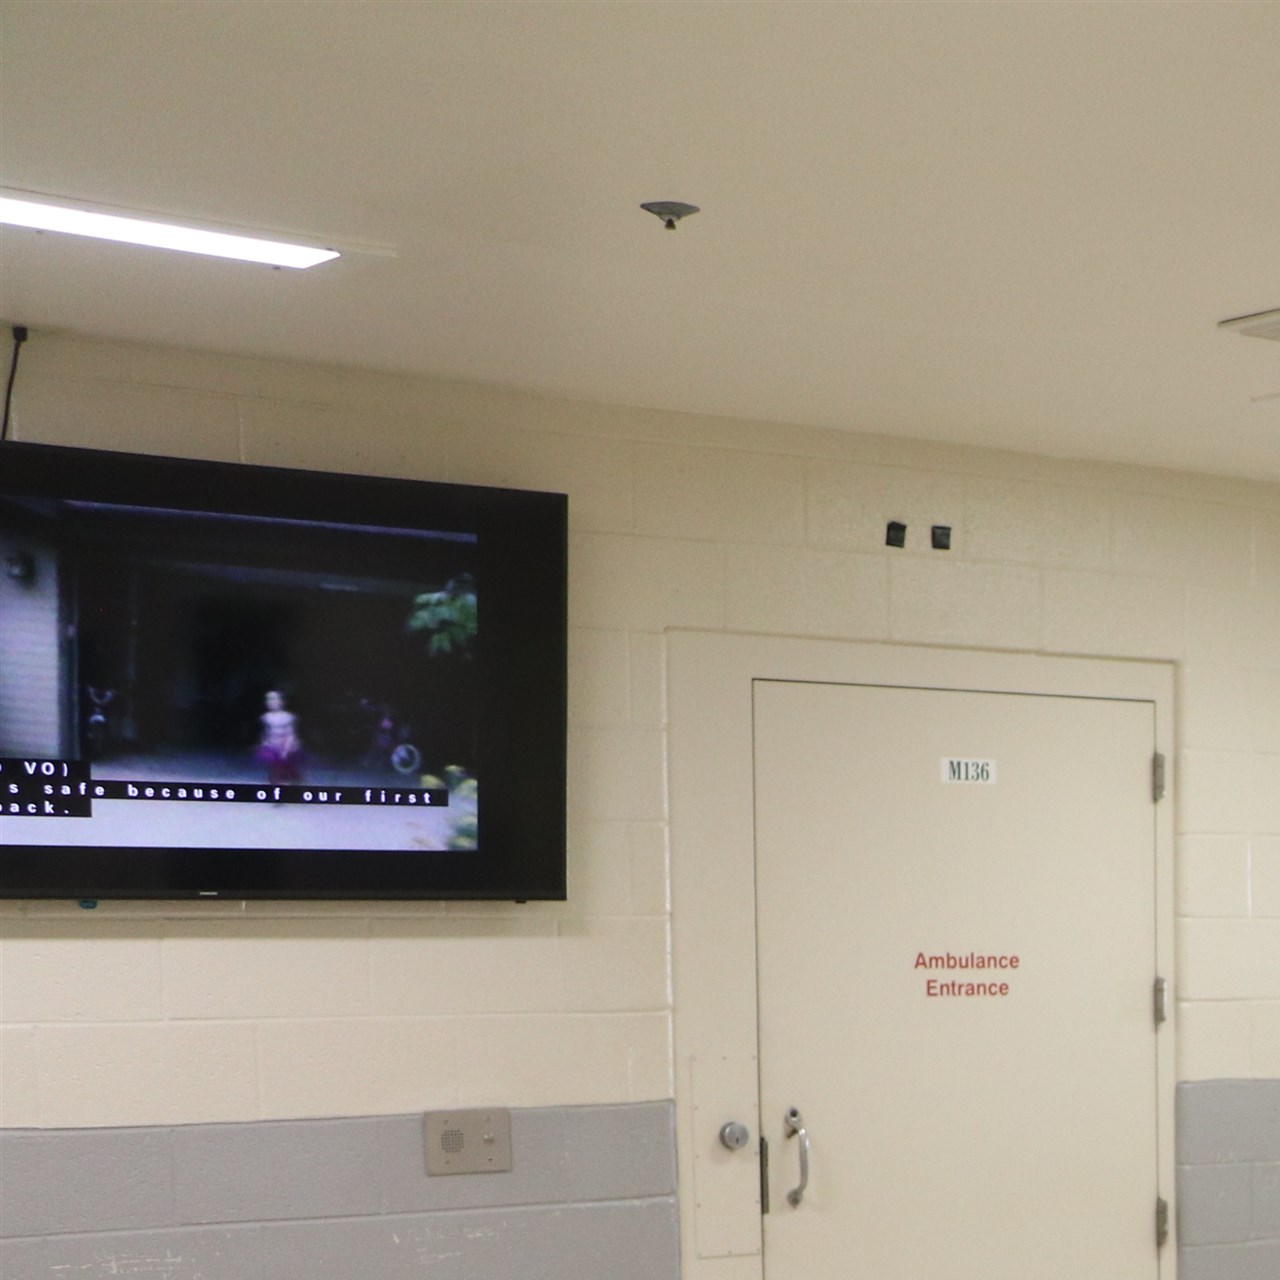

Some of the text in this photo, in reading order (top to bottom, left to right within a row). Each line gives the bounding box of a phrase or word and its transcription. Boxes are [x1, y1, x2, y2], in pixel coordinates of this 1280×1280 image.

[23, 761, 69, 777] VO)
[948, 760, 990, 782] M136
[43, 782, 105, 796] safe
[127, 783, 235, 800] because
[256, 787, 282, 801] of
[303, 791, 343, 802] our
[365, 789, 431, 804] first
[914, 952, 1020, 970] Ambulance
[926, 979, 1010, 997] Entrance
